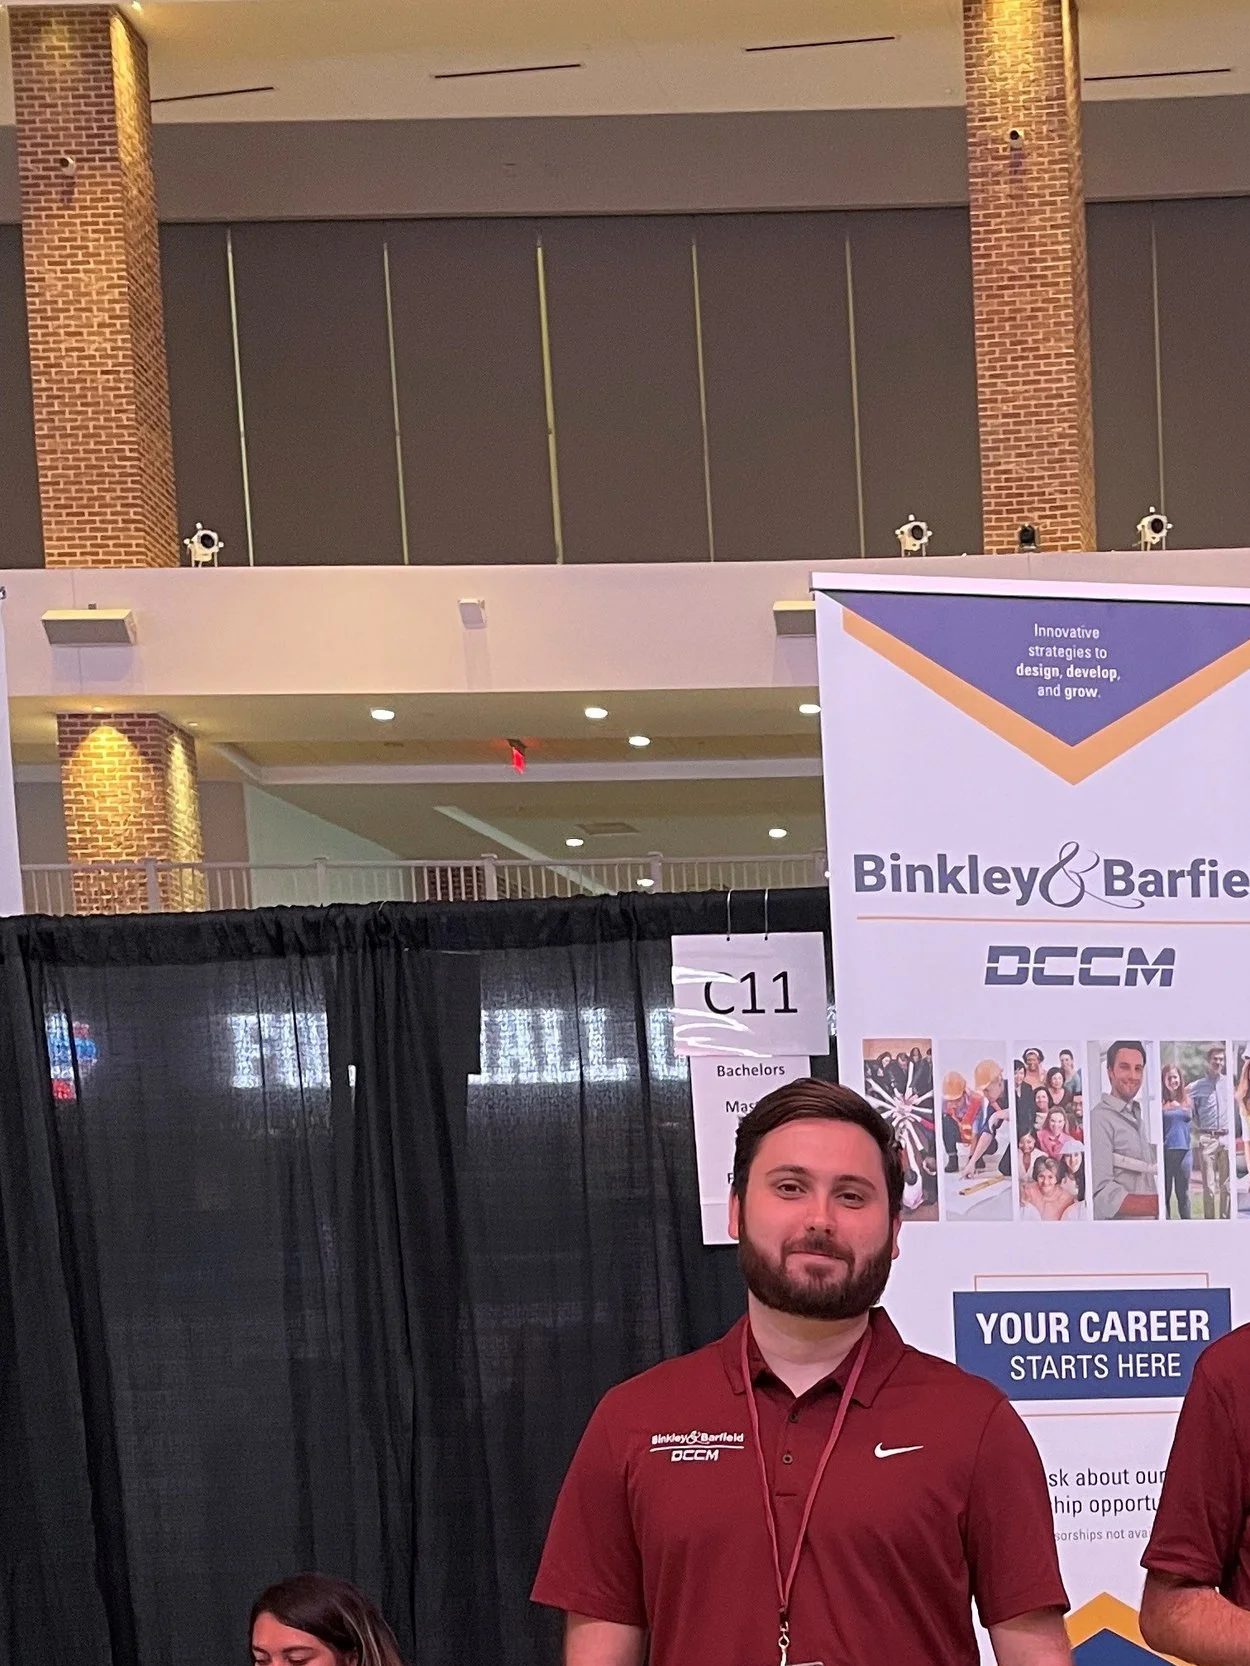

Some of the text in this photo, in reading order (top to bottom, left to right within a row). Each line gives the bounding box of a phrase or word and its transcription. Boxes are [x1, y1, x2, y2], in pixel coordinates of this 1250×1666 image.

[1033, 623, 1101, 641] Innovative
[1028, 645, 1108, 661] strategies to
[1016, 663, 1122, 683] design, develop,
[1037, 684, 1101, 701] and grow.
[984, 945, 1177, 988] DCCM
[703, 970, 799, 1015] C11
[716, 1062, 785, 1078] Bachelors
[725, 1100, 759, 1113] Mas
[976, 1310, 1210, 1345] YOUR CAREER
[1010, 1352, 1182, 1381] STARTS HERE
[670, 1448, 719, 1462] DCCM
[1048, 1468, 1069, 1487] sk
[1075, 1467, 1129, 1486] about
[1053, 1494, 1159, 1517] hip opportu
[1055, 1528, 1103, 1542] sorships
[1106, 1528, 1125, 1540] not
